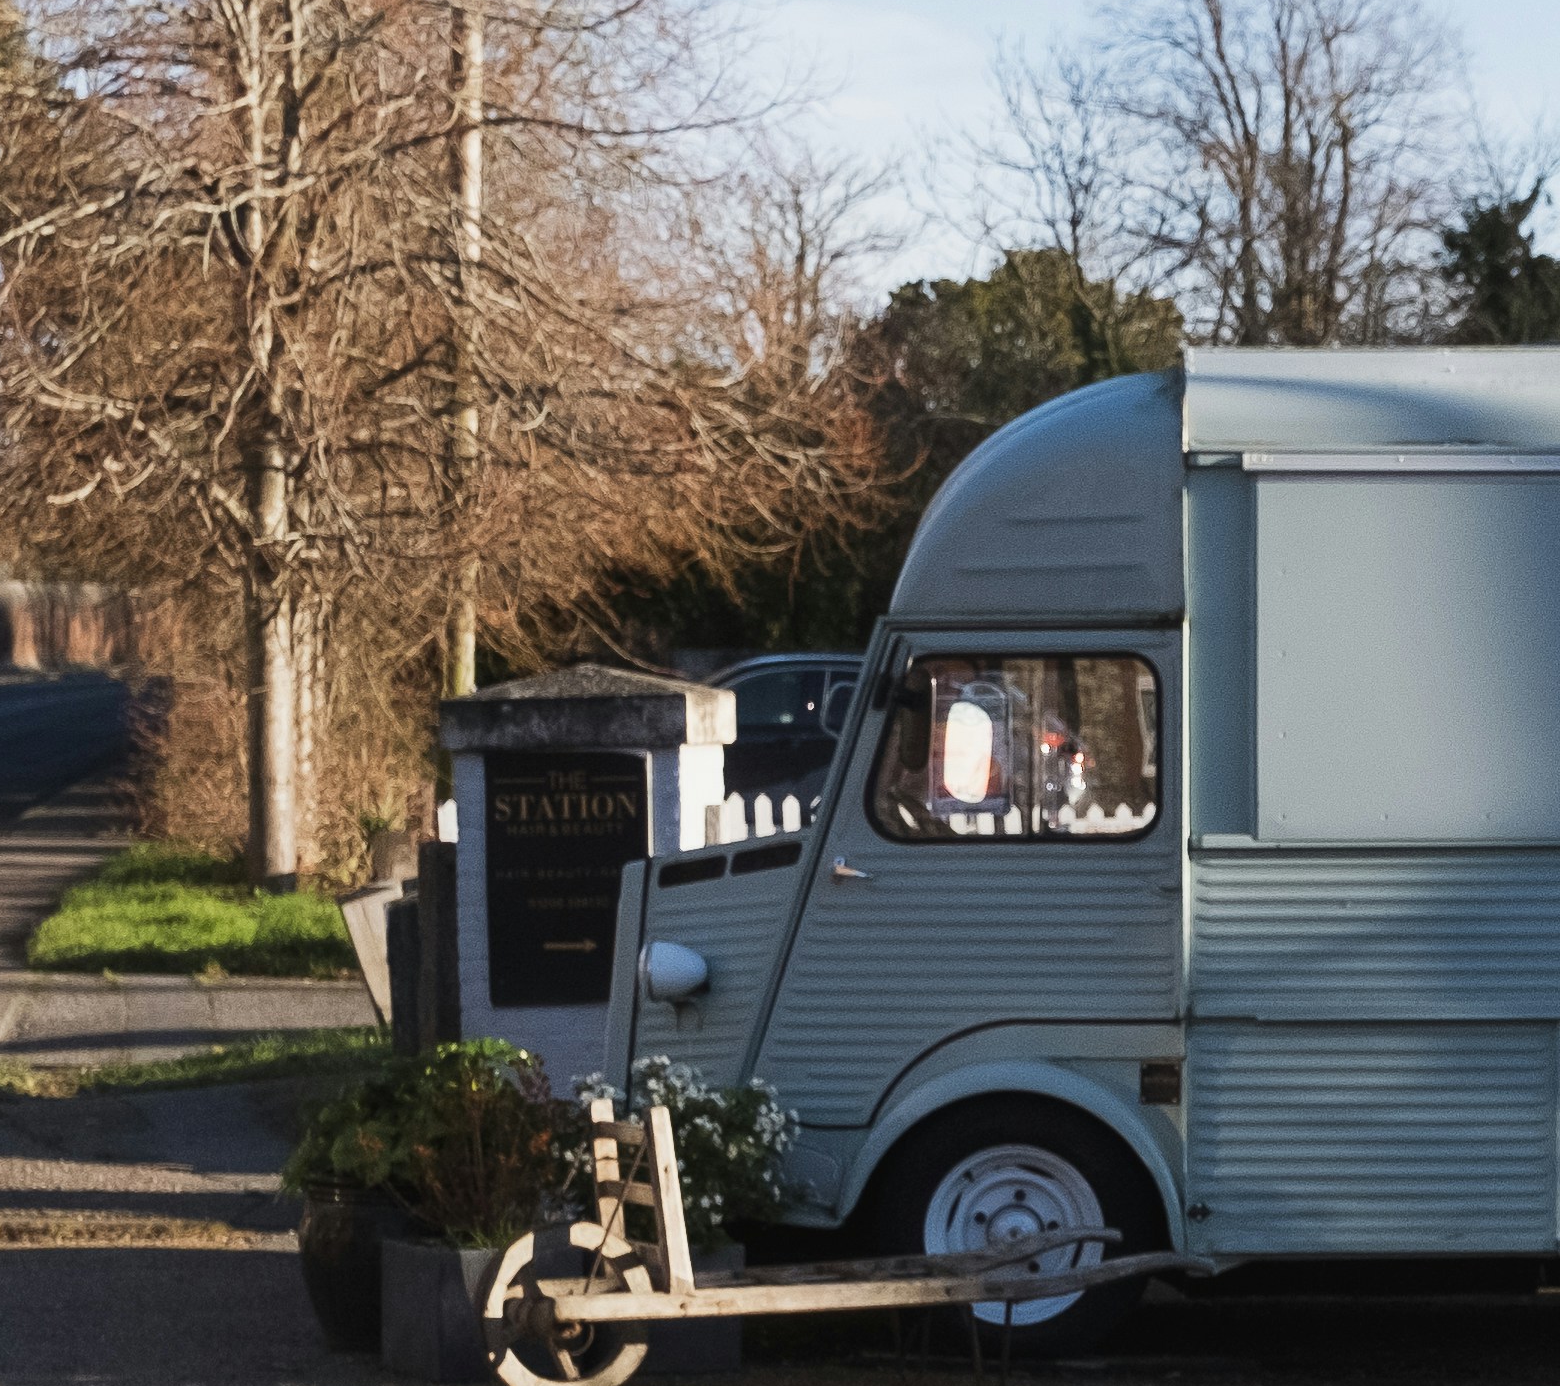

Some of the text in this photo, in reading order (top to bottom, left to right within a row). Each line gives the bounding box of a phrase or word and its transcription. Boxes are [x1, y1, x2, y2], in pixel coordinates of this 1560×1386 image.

[547, 770, 587, 790] THE
[494, 792, 637, 821] STATION
[561, 821, 625, 836] BEAUTY
